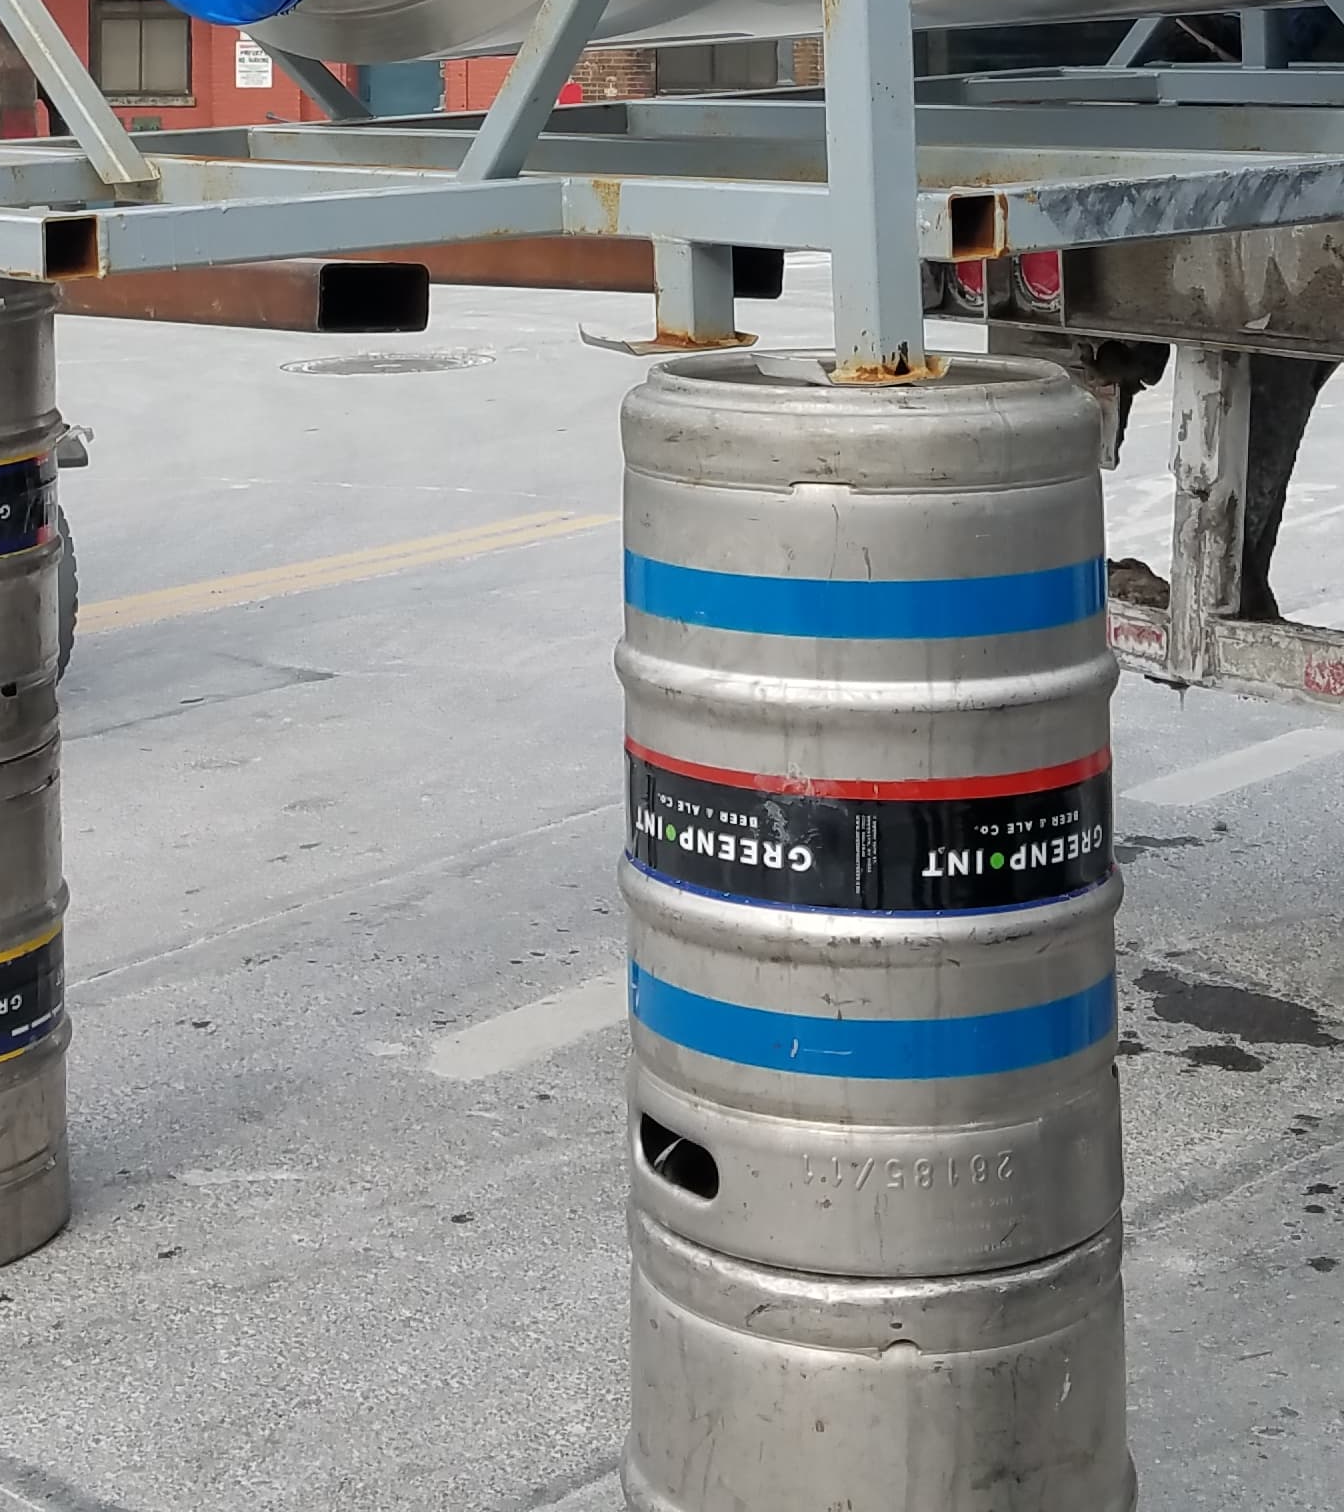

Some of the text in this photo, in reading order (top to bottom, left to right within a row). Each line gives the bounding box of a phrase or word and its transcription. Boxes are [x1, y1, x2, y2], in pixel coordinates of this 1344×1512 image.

[677, 799, 701, 817] ALE
[719, 810, 759, 829] BEER
[1006, 819, 1033, 835] ALE
[1051, 809, 1079, 827] BEER
